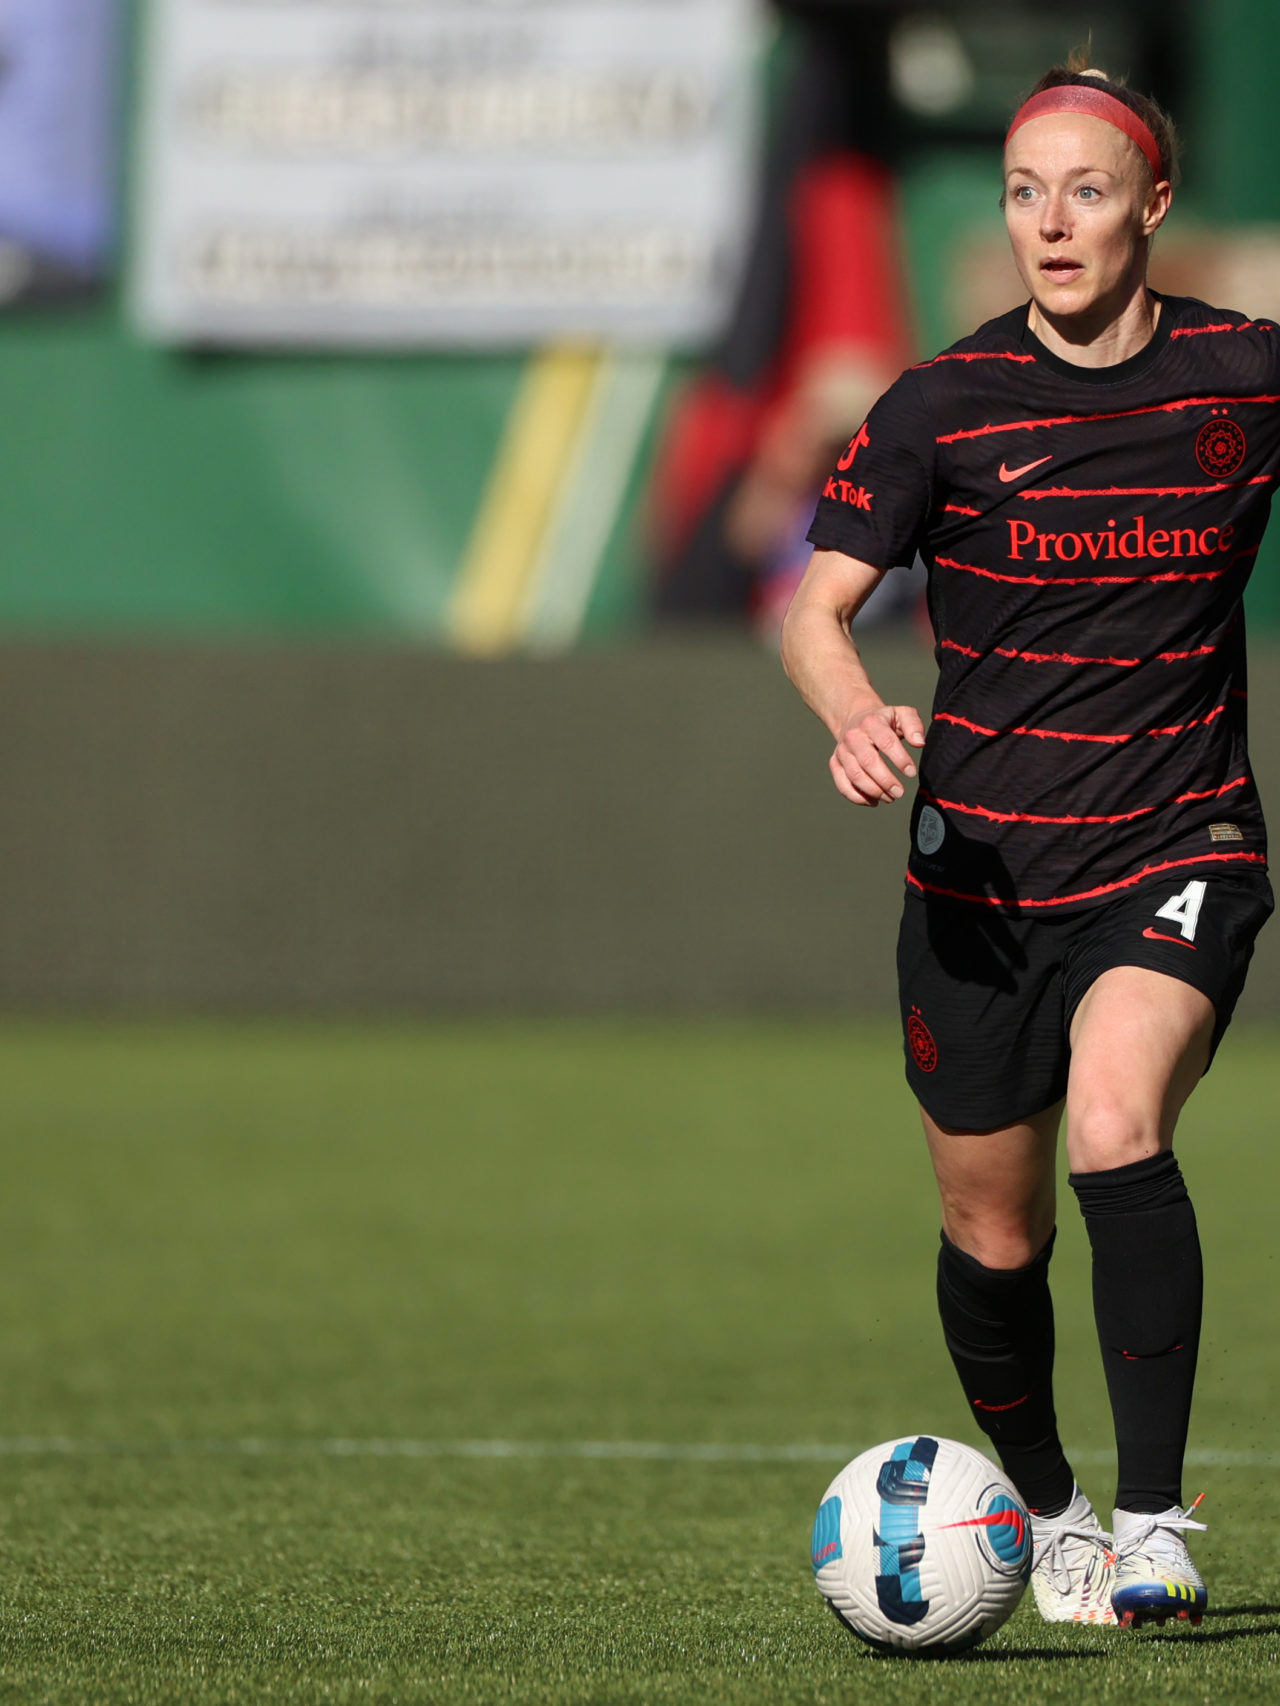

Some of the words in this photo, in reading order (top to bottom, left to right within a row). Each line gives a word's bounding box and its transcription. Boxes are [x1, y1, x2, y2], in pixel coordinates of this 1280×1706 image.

[822, 475, 875, 511] kTok
[1006, 515, 1234, 561] Providence
[1154, 880, 1208, 942] 4
